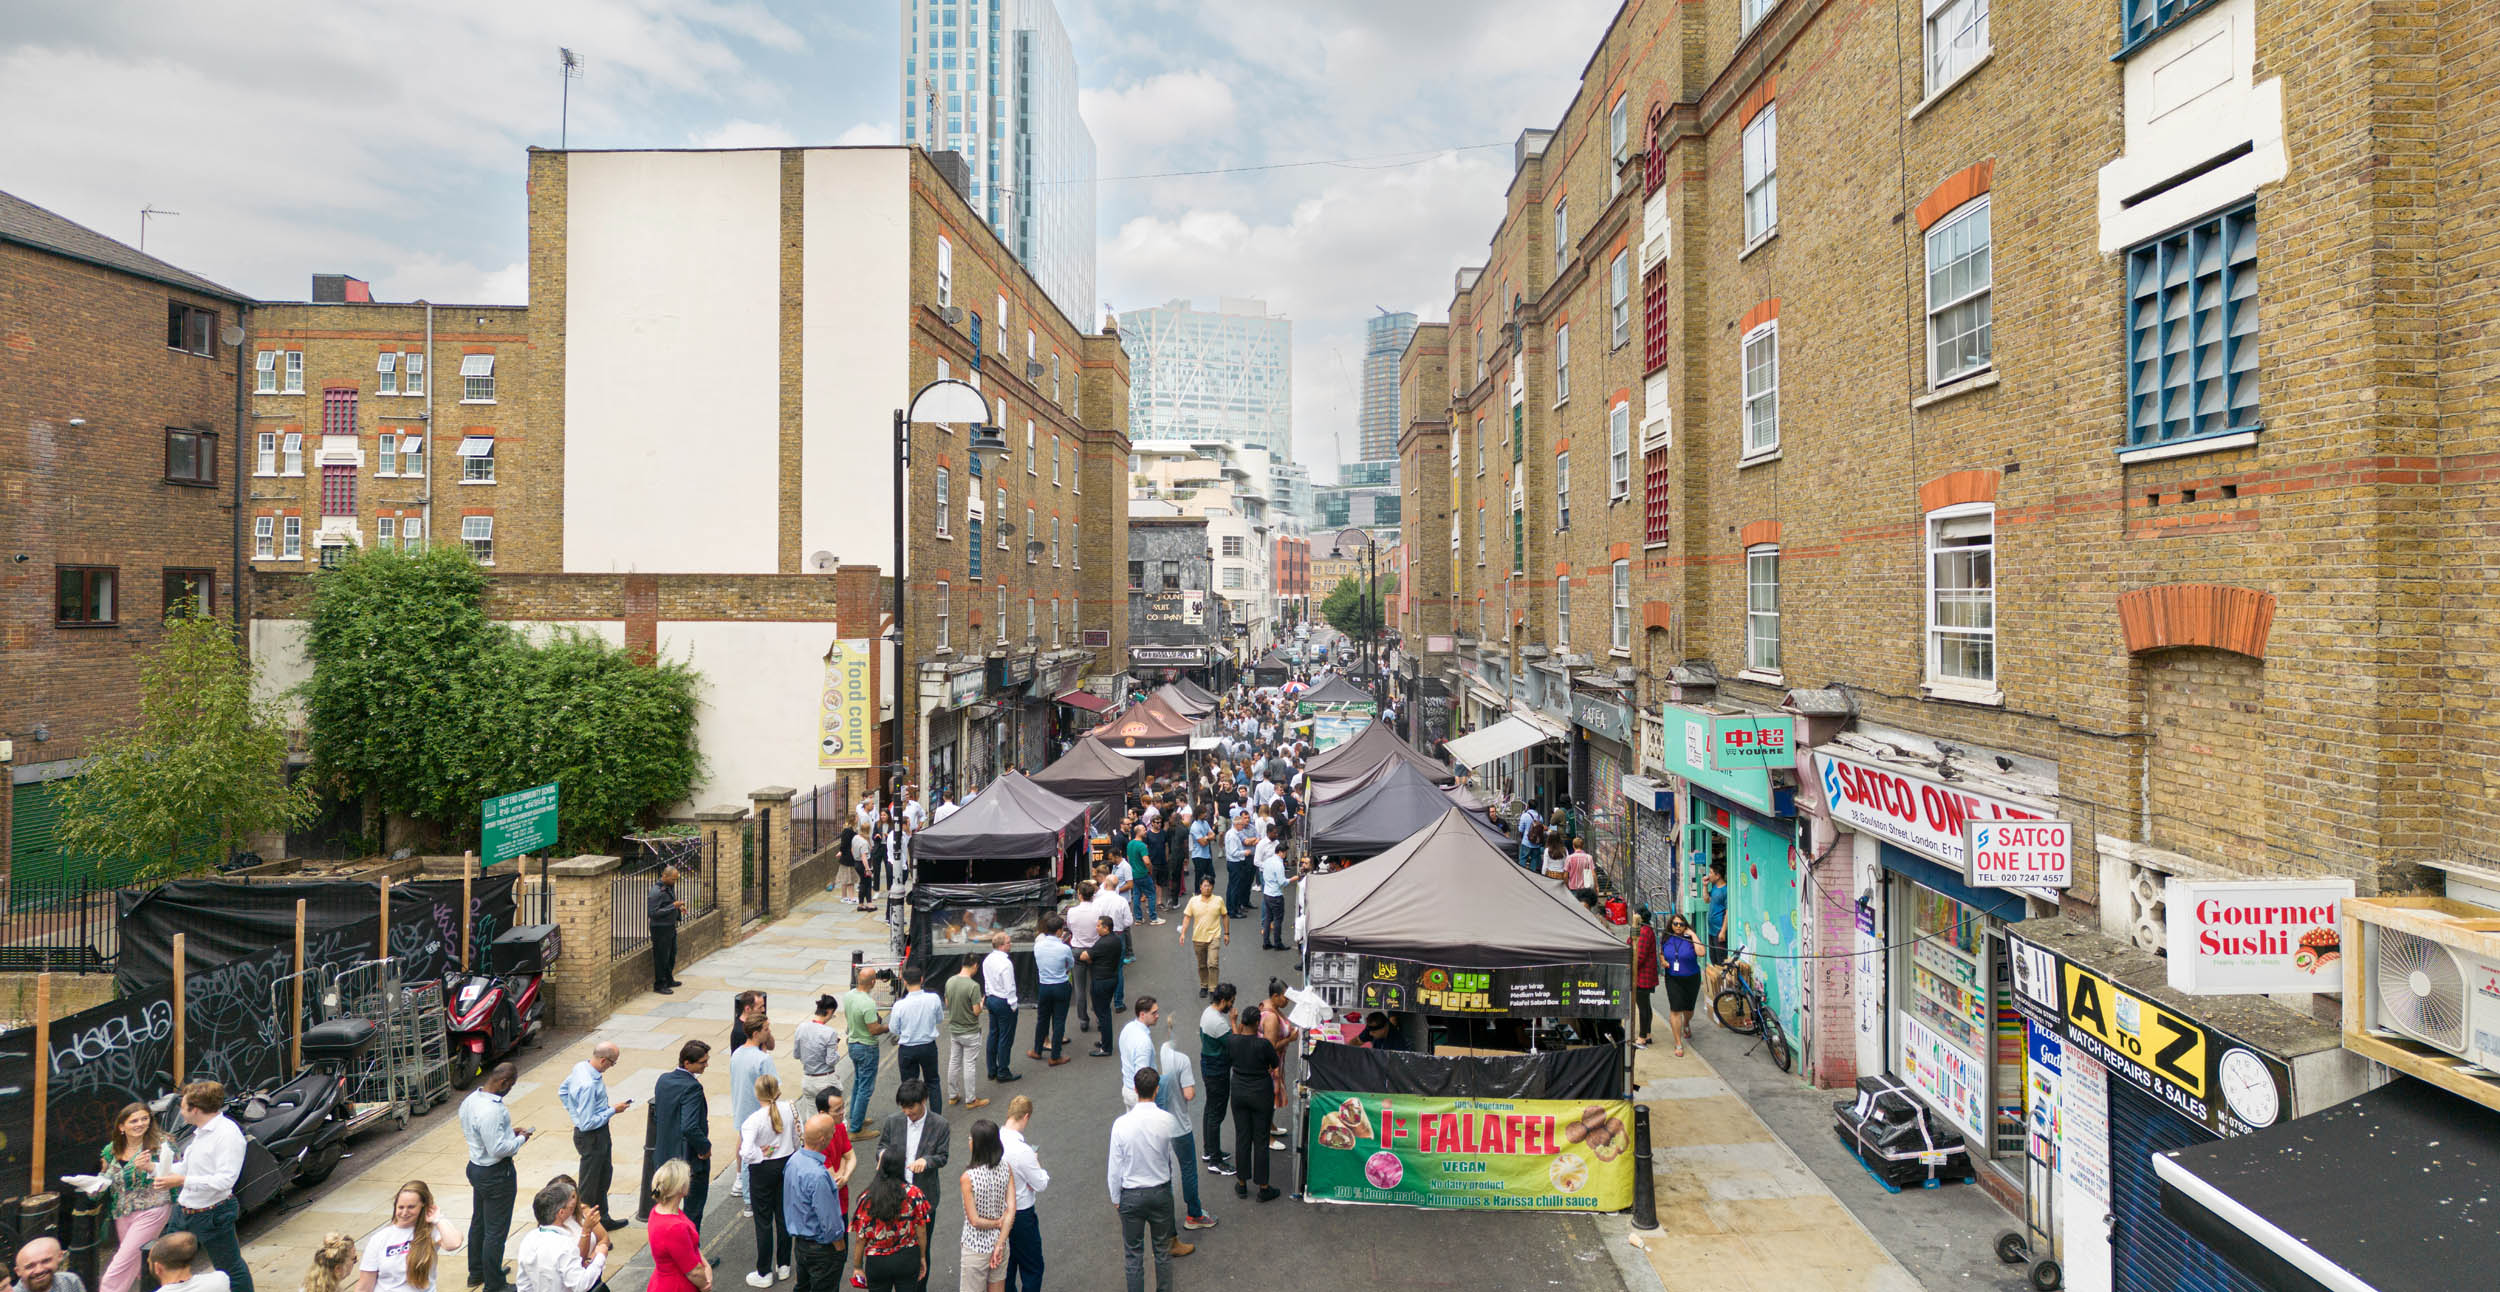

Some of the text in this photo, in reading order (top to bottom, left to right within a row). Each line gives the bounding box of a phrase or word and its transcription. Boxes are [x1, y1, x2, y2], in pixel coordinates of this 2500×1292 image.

[848, 661, 866, 755] food court
[1725, 729, 1784, 747] 中超
[1838, 762, 1917, 823] SATCO
[1860, 812, 1888, 833] Goulston
[1942, 842, 1952, 855] E1
[1954, 846, 1964, 859] 7T
[1998, 827, 2065, 847] SATCO
[1978, 852, 2065, 871] ONE LTD
[2001, 873, 2017, 882] 020
[2020, 873, 2040, 882] 7247
[2042, 874, 2064, 882] 4557
[2196, 898, 2337, 926] Gourmet
[2200, 929, 2289, 956] Sushi
[464, 988, 472, 997] L
[1579, 998, 1610, 1006] Aubergine
[2071, 973, 2108, 1038] A
[2116, 1029, 2142, 1056] TO
[2155, 1012, 2199, 1090] Z
[2068, 1023, 2207, 1121] WATCH REPAIRS & SALES
[1474, 1101, 1514, 1111] Vegetarian
[1419, 1112, 1561, 1155] FALAFEL
[1442, 1160, 1486, 1173] VEGAN
[1431, 1179, 1504, 1191] No dairy product
[1364, 1188, 1392, 1200] Home
[1427, 1193, 1481, 1207] Hummous
[1484, 1197, 1490, 1206] &
[1494, 1195, 1533, 1207] Harissa
[1536, 1195, 1563, 1207] chilli
[1566, 1197, 1598, 1208] sauce
